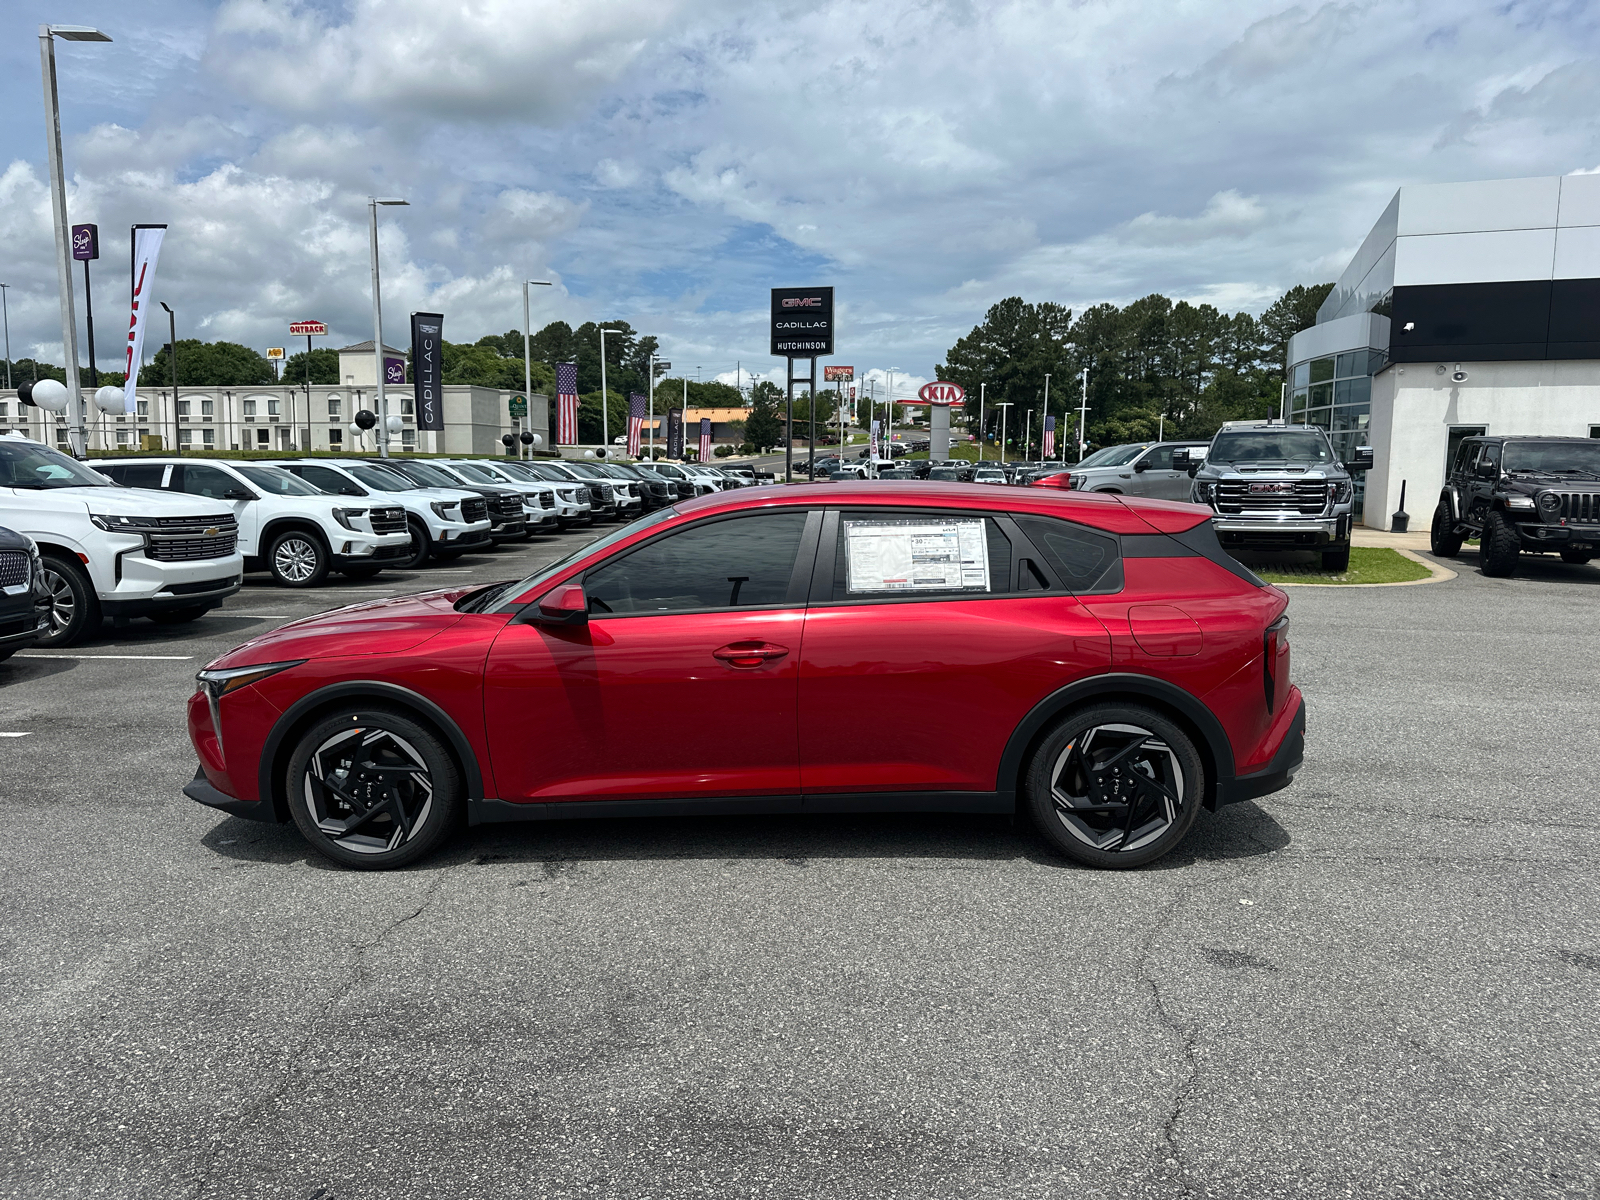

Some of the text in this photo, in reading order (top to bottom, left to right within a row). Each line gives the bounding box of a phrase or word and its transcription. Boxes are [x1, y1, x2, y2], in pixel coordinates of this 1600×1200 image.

[74, 234, 89, 248] Sleep
[782, 297, 821, 307] GMC
[290, 325, 324, 333] OUTBACK
[776, 321, 827, 329] CADILLAC
[777, 341, 826, 350] HUTCHINSON
[388, 366, 402, 380] Sleep
[424, 339, 434, 423] CADILLAC
[927, 387, 957, 400] KIA
[1252, 484, 1291, 492] GMC
